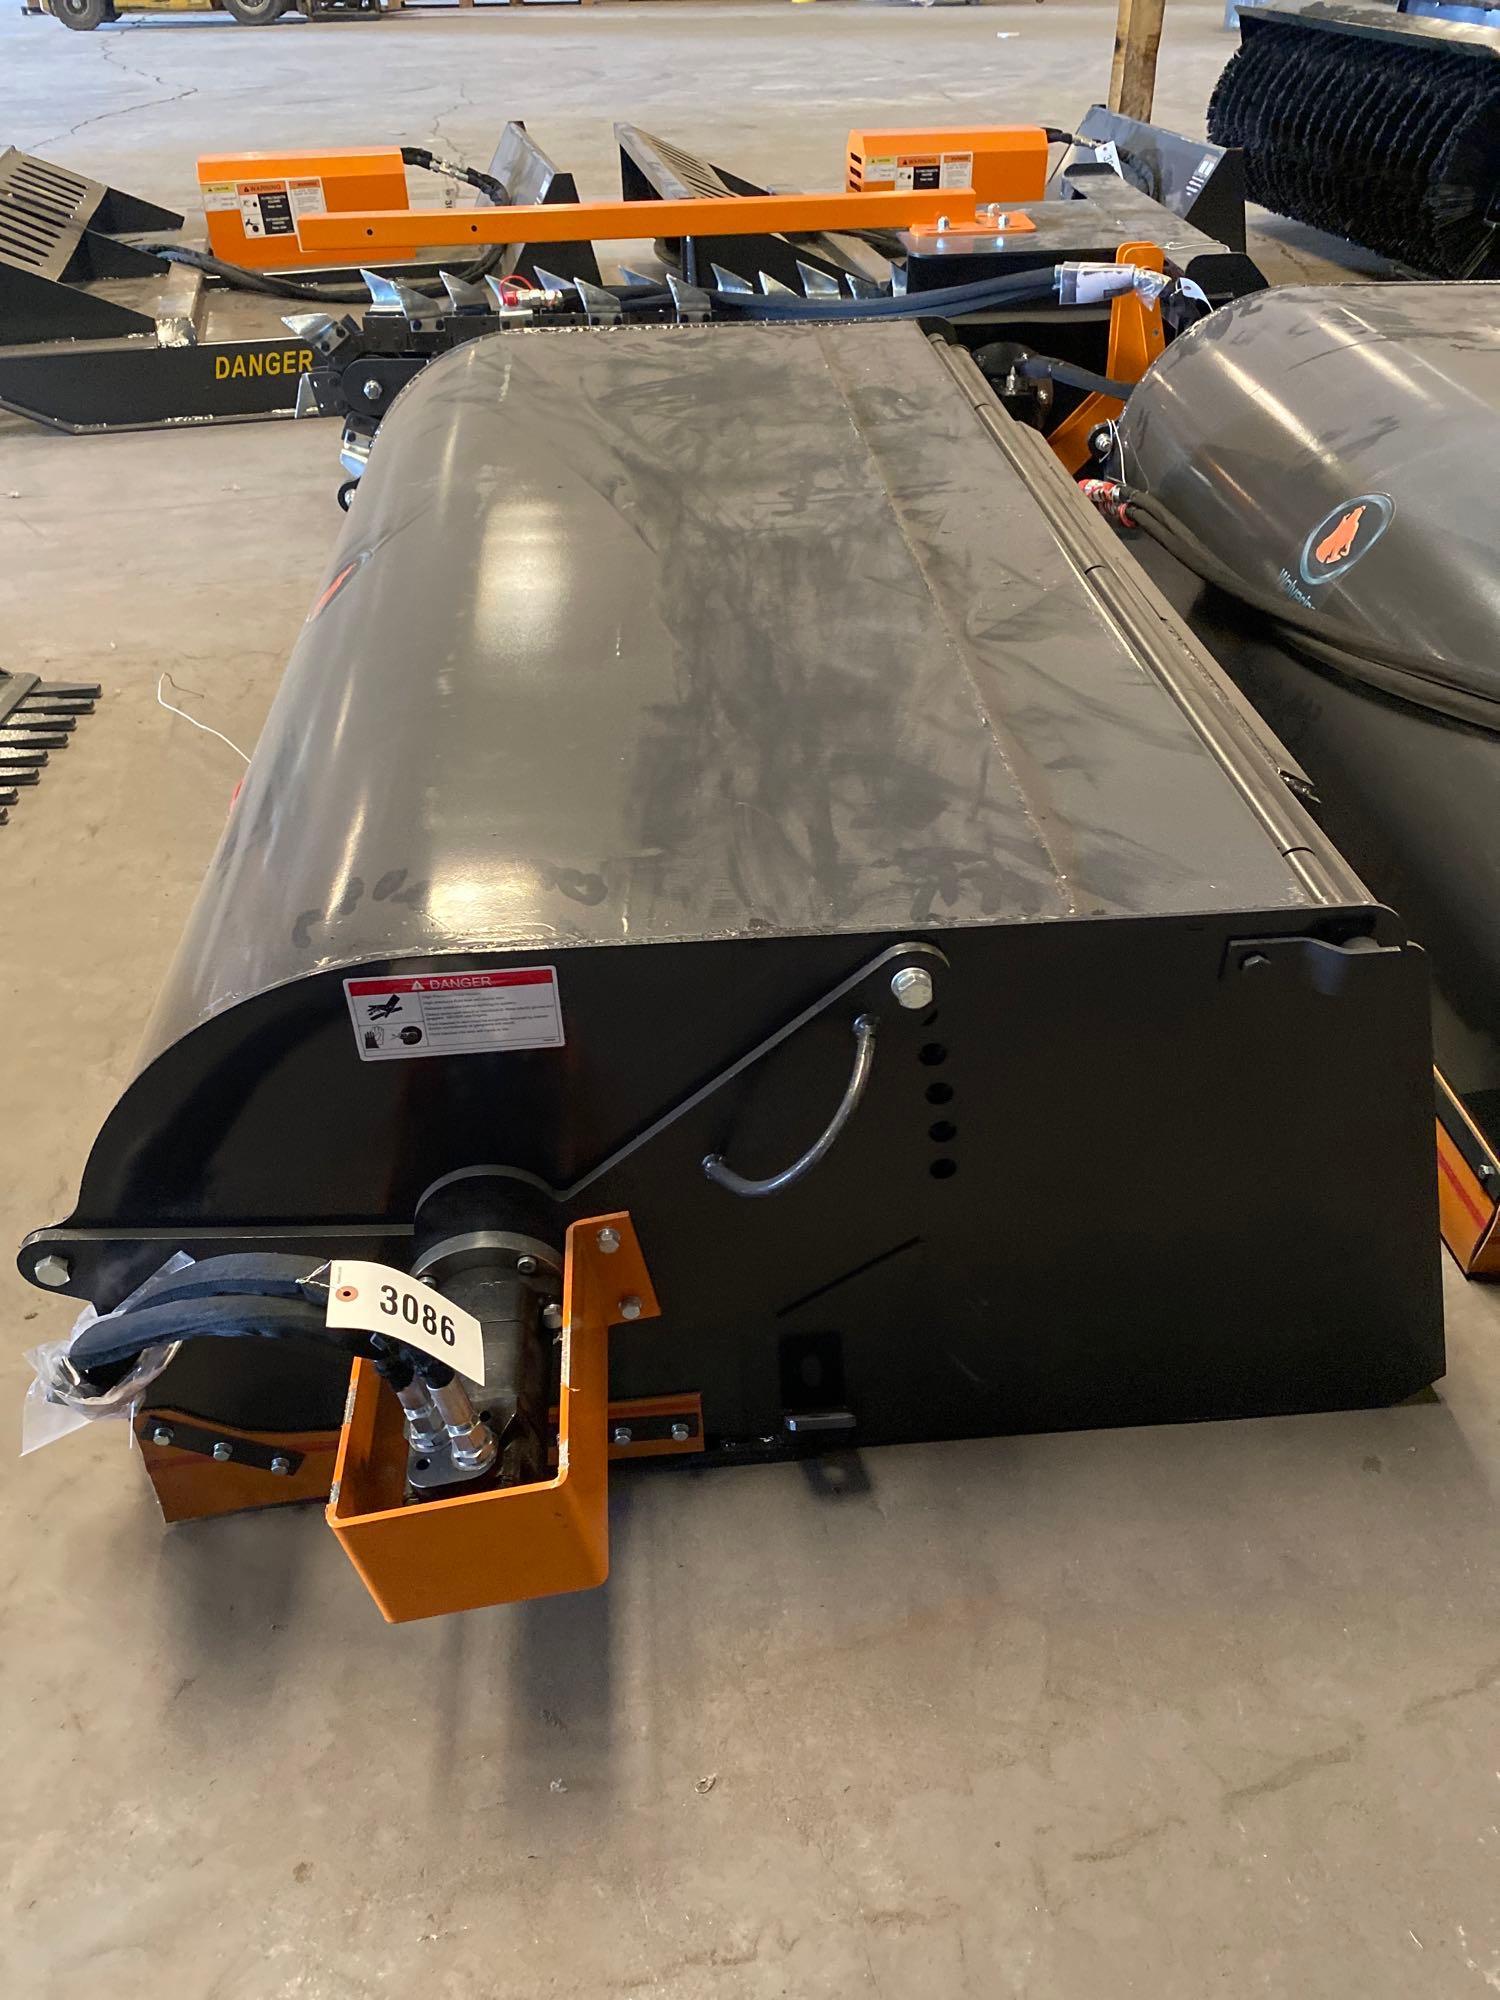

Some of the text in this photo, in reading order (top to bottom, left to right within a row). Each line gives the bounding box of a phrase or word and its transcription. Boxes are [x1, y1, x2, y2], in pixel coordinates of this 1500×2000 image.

[215, 349, 313, 379] DANGER
[429, 976, 492, 990] DANGER
[379, 1284, 456, 1347] 3086
